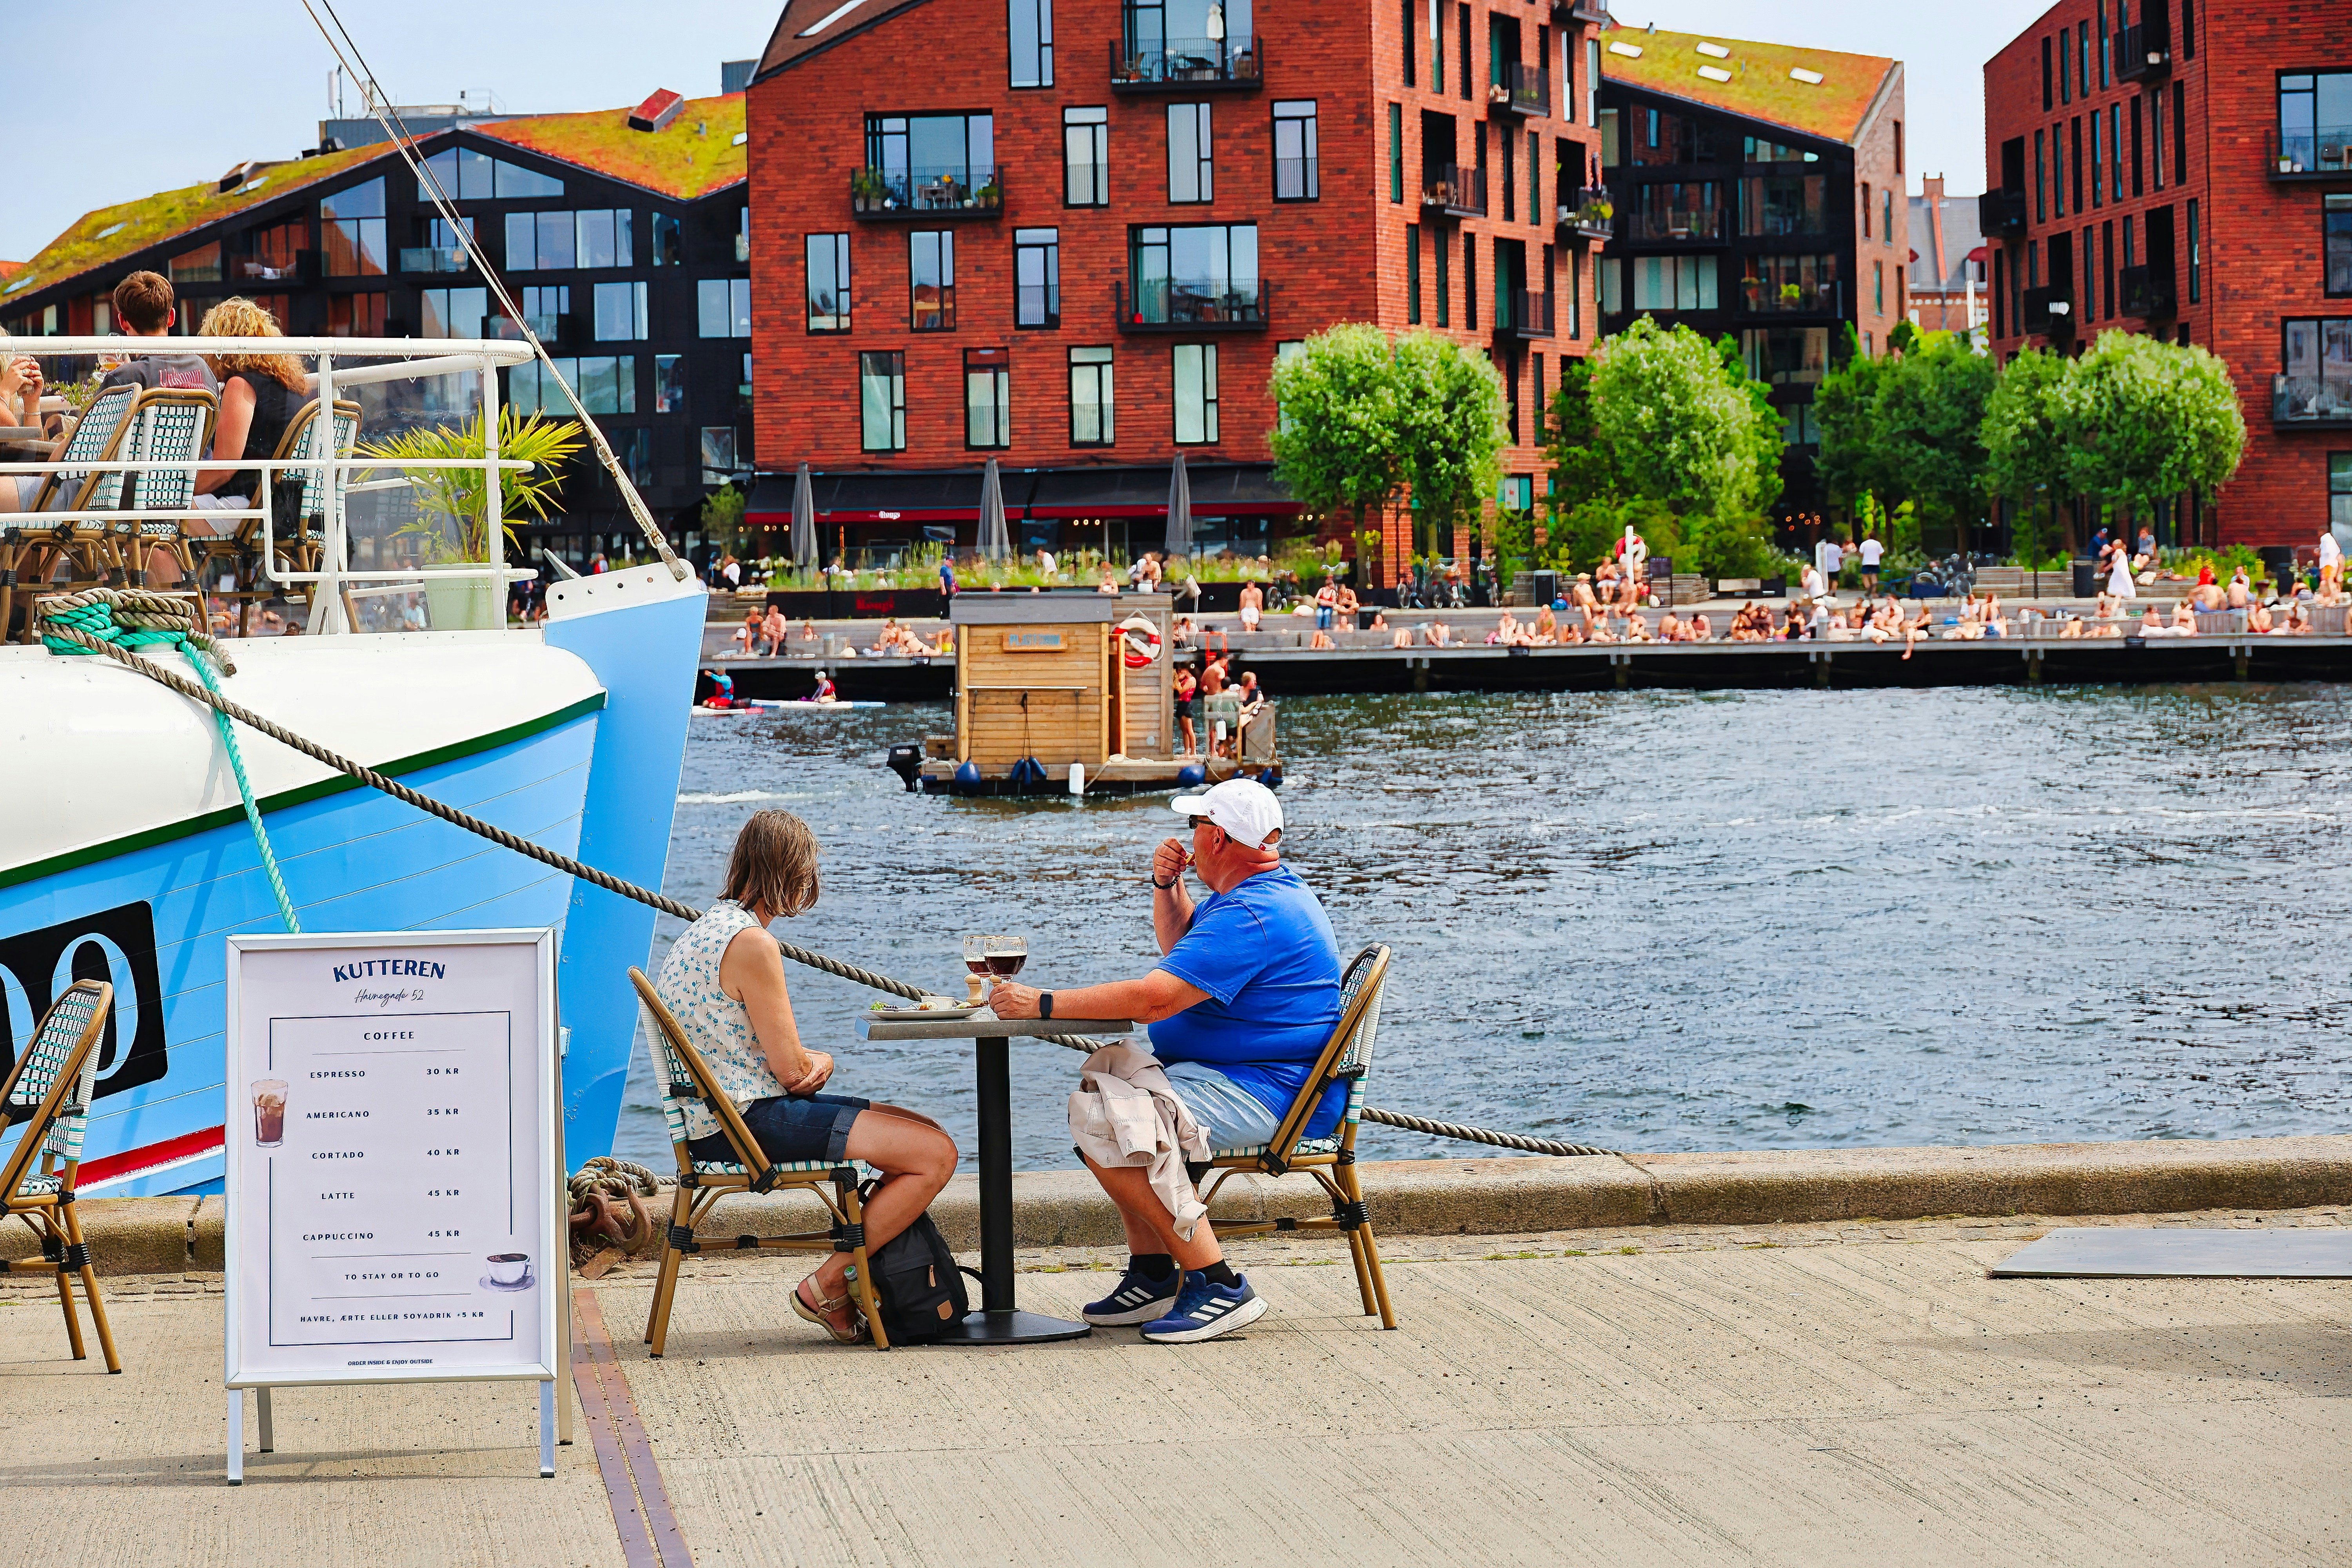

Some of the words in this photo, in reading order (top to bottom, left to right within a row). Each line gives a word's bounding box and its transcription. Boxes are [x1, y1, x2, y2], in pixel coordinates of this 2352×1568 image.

[333, 959, 446, 983] KUTTEREN
[354, 988, 409, 1007] Havnegade
[411, 989, 424, 1001] 52
[363, 1031, 415, 1040] COFFEE
[310, 1070, 365, 1078] ESPRESSO
[306, 1111, 369, 1120] AMERICANO
[312, 1151, 364, 1160] CORTADO
[303, 1232, 374, 1241] CAPPUCCINO
